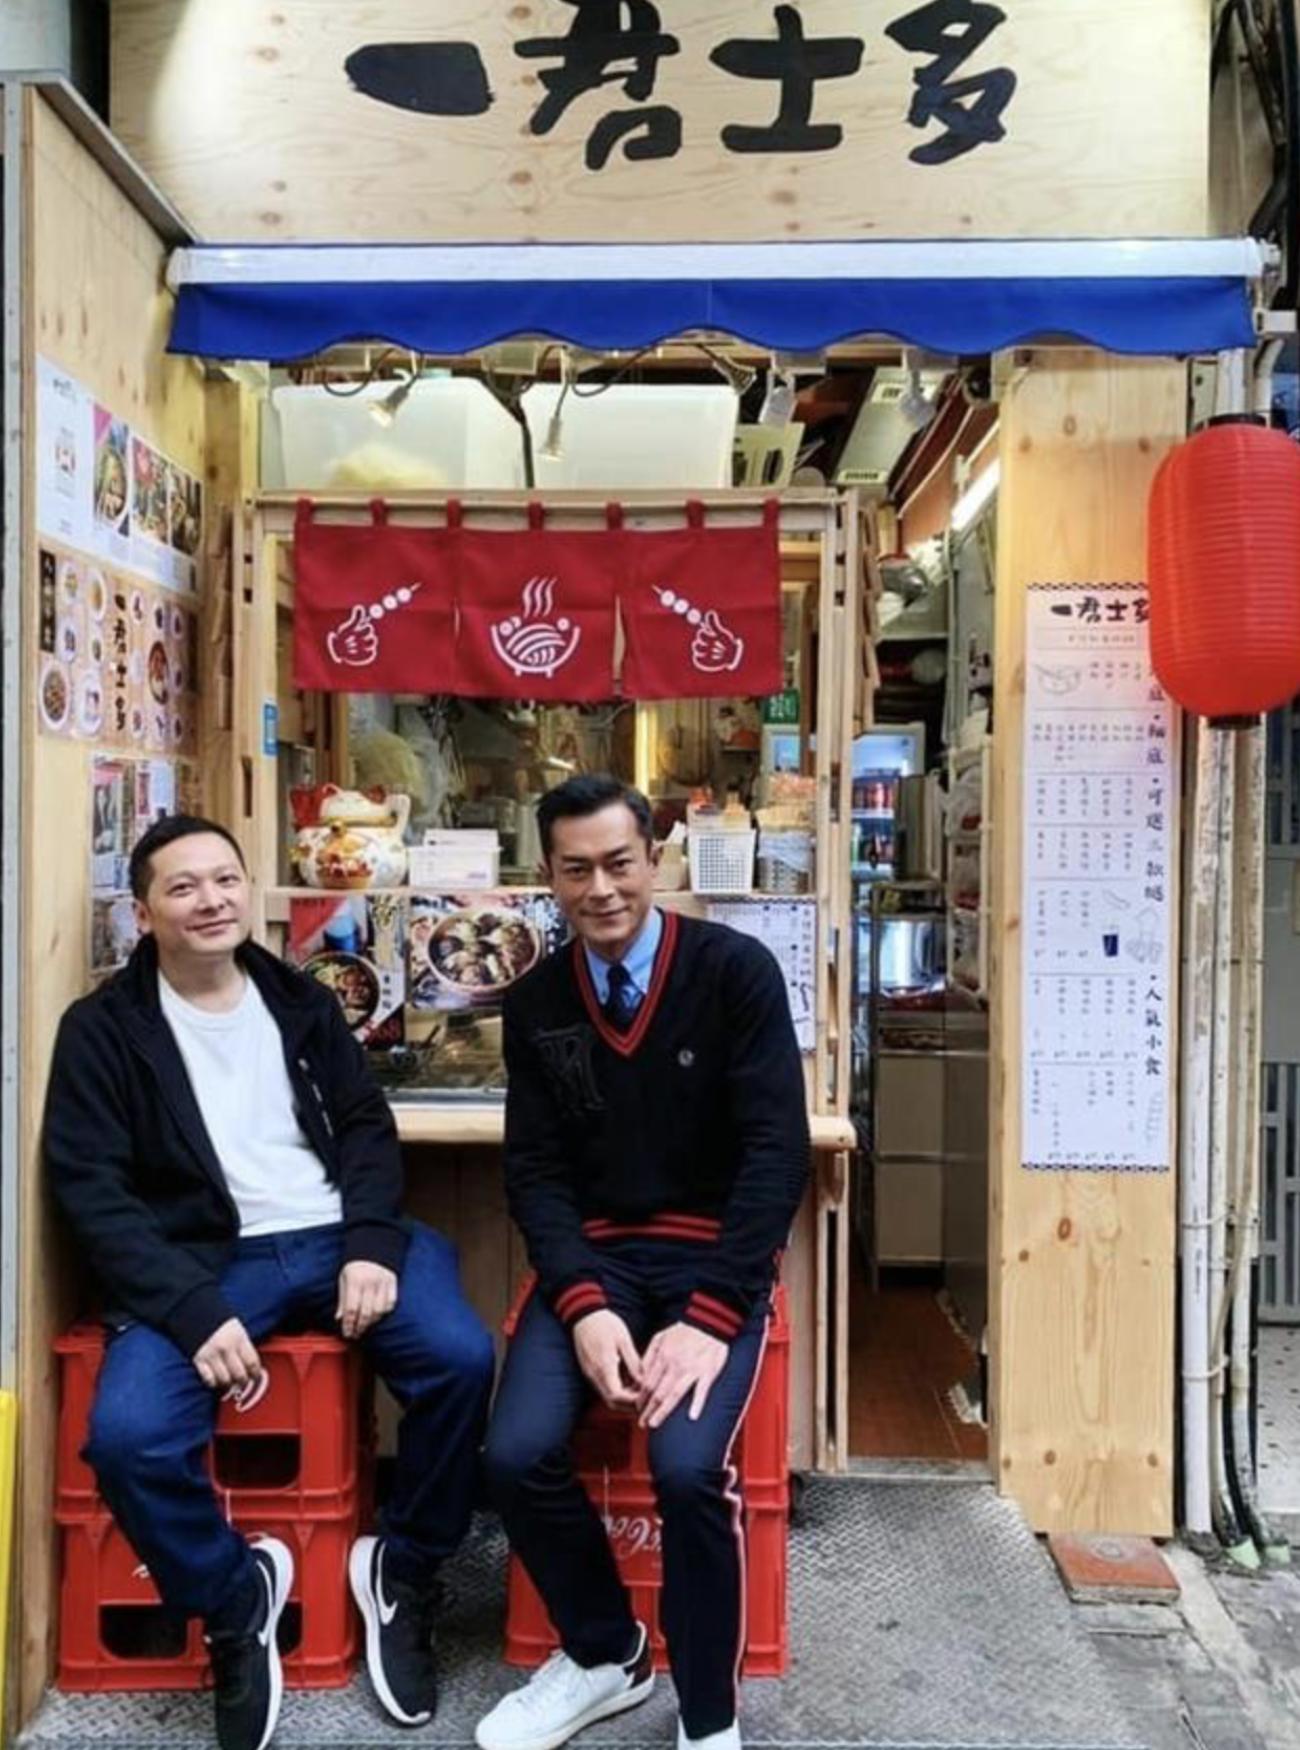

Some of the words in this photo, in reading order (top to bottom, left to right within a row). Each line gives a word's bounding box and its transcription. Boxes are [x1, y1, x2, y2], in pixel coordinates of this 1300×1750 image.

[344, 0, 1018, 170] 一君士多
[113, 593, 127, 731] 一君士多
[1050, 596, 1150, 624] 一君士多
